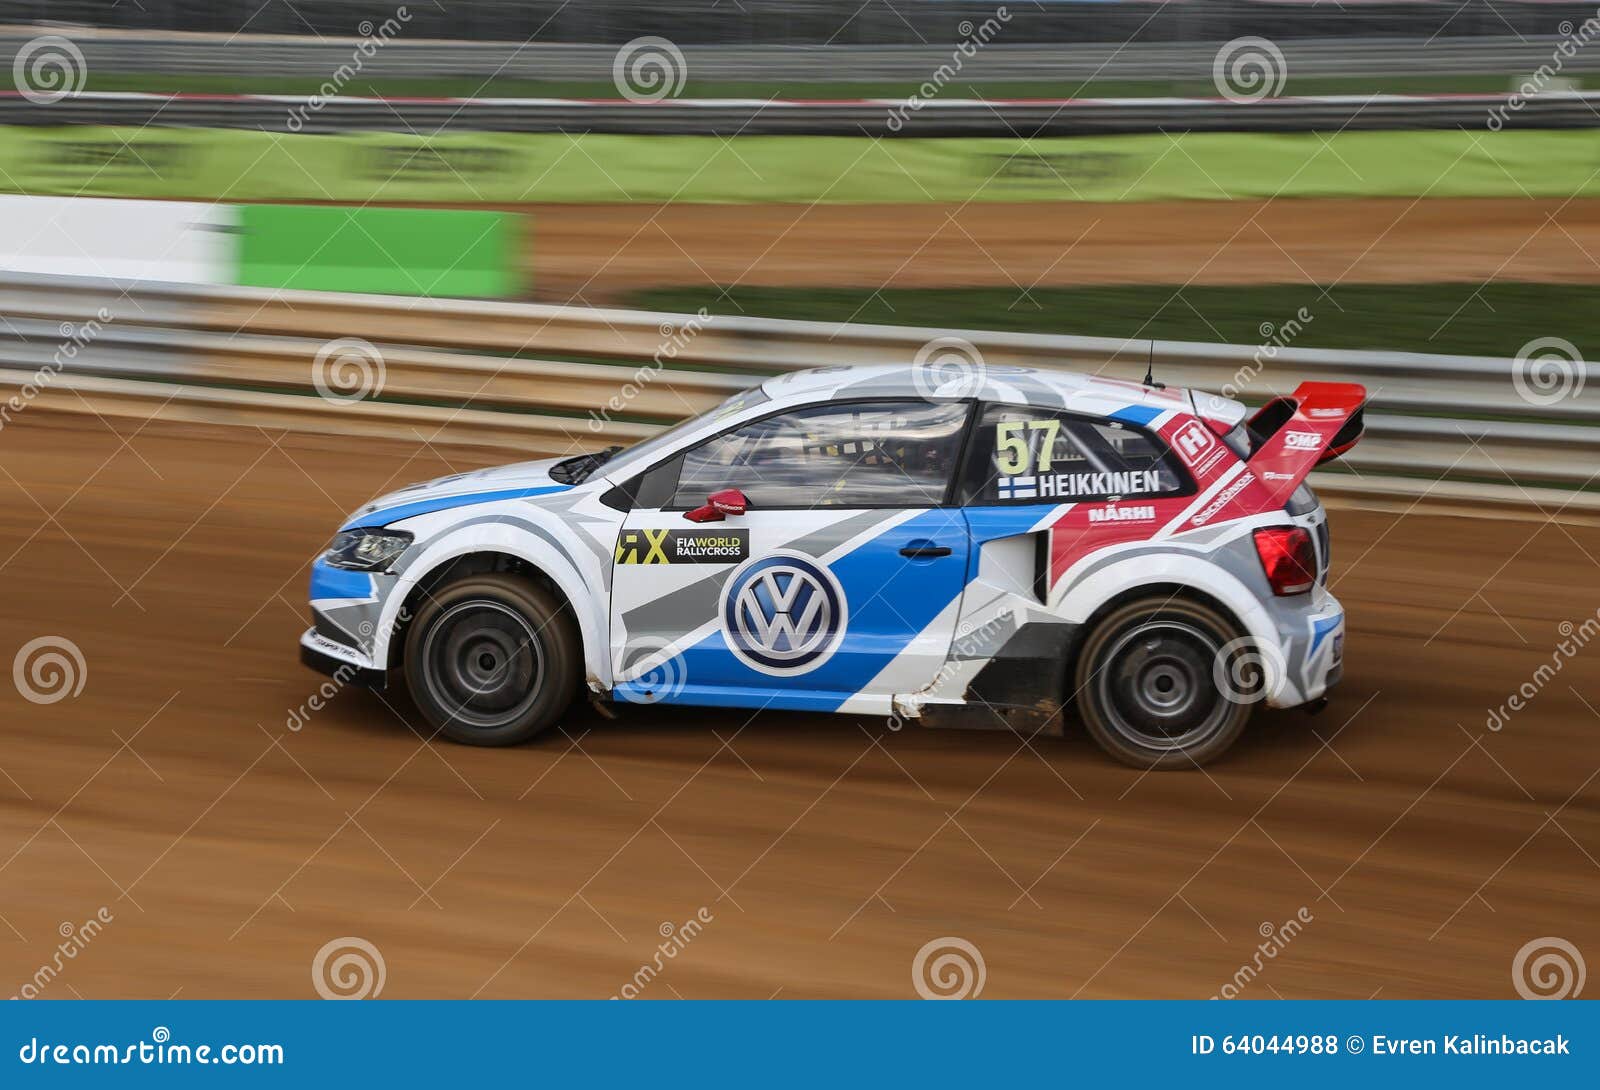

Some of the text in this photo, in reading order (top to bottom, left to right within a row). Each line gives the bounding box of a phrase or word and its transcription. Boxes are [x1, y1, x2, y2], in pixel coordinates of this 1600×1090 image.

[996, 419, 1061, 475] 57
[1178, 426, 1209, 457] H
[1039, 470, 1160, 497] HEIKKINEN
[676, 546, 741, 556] RALLYCROSS
